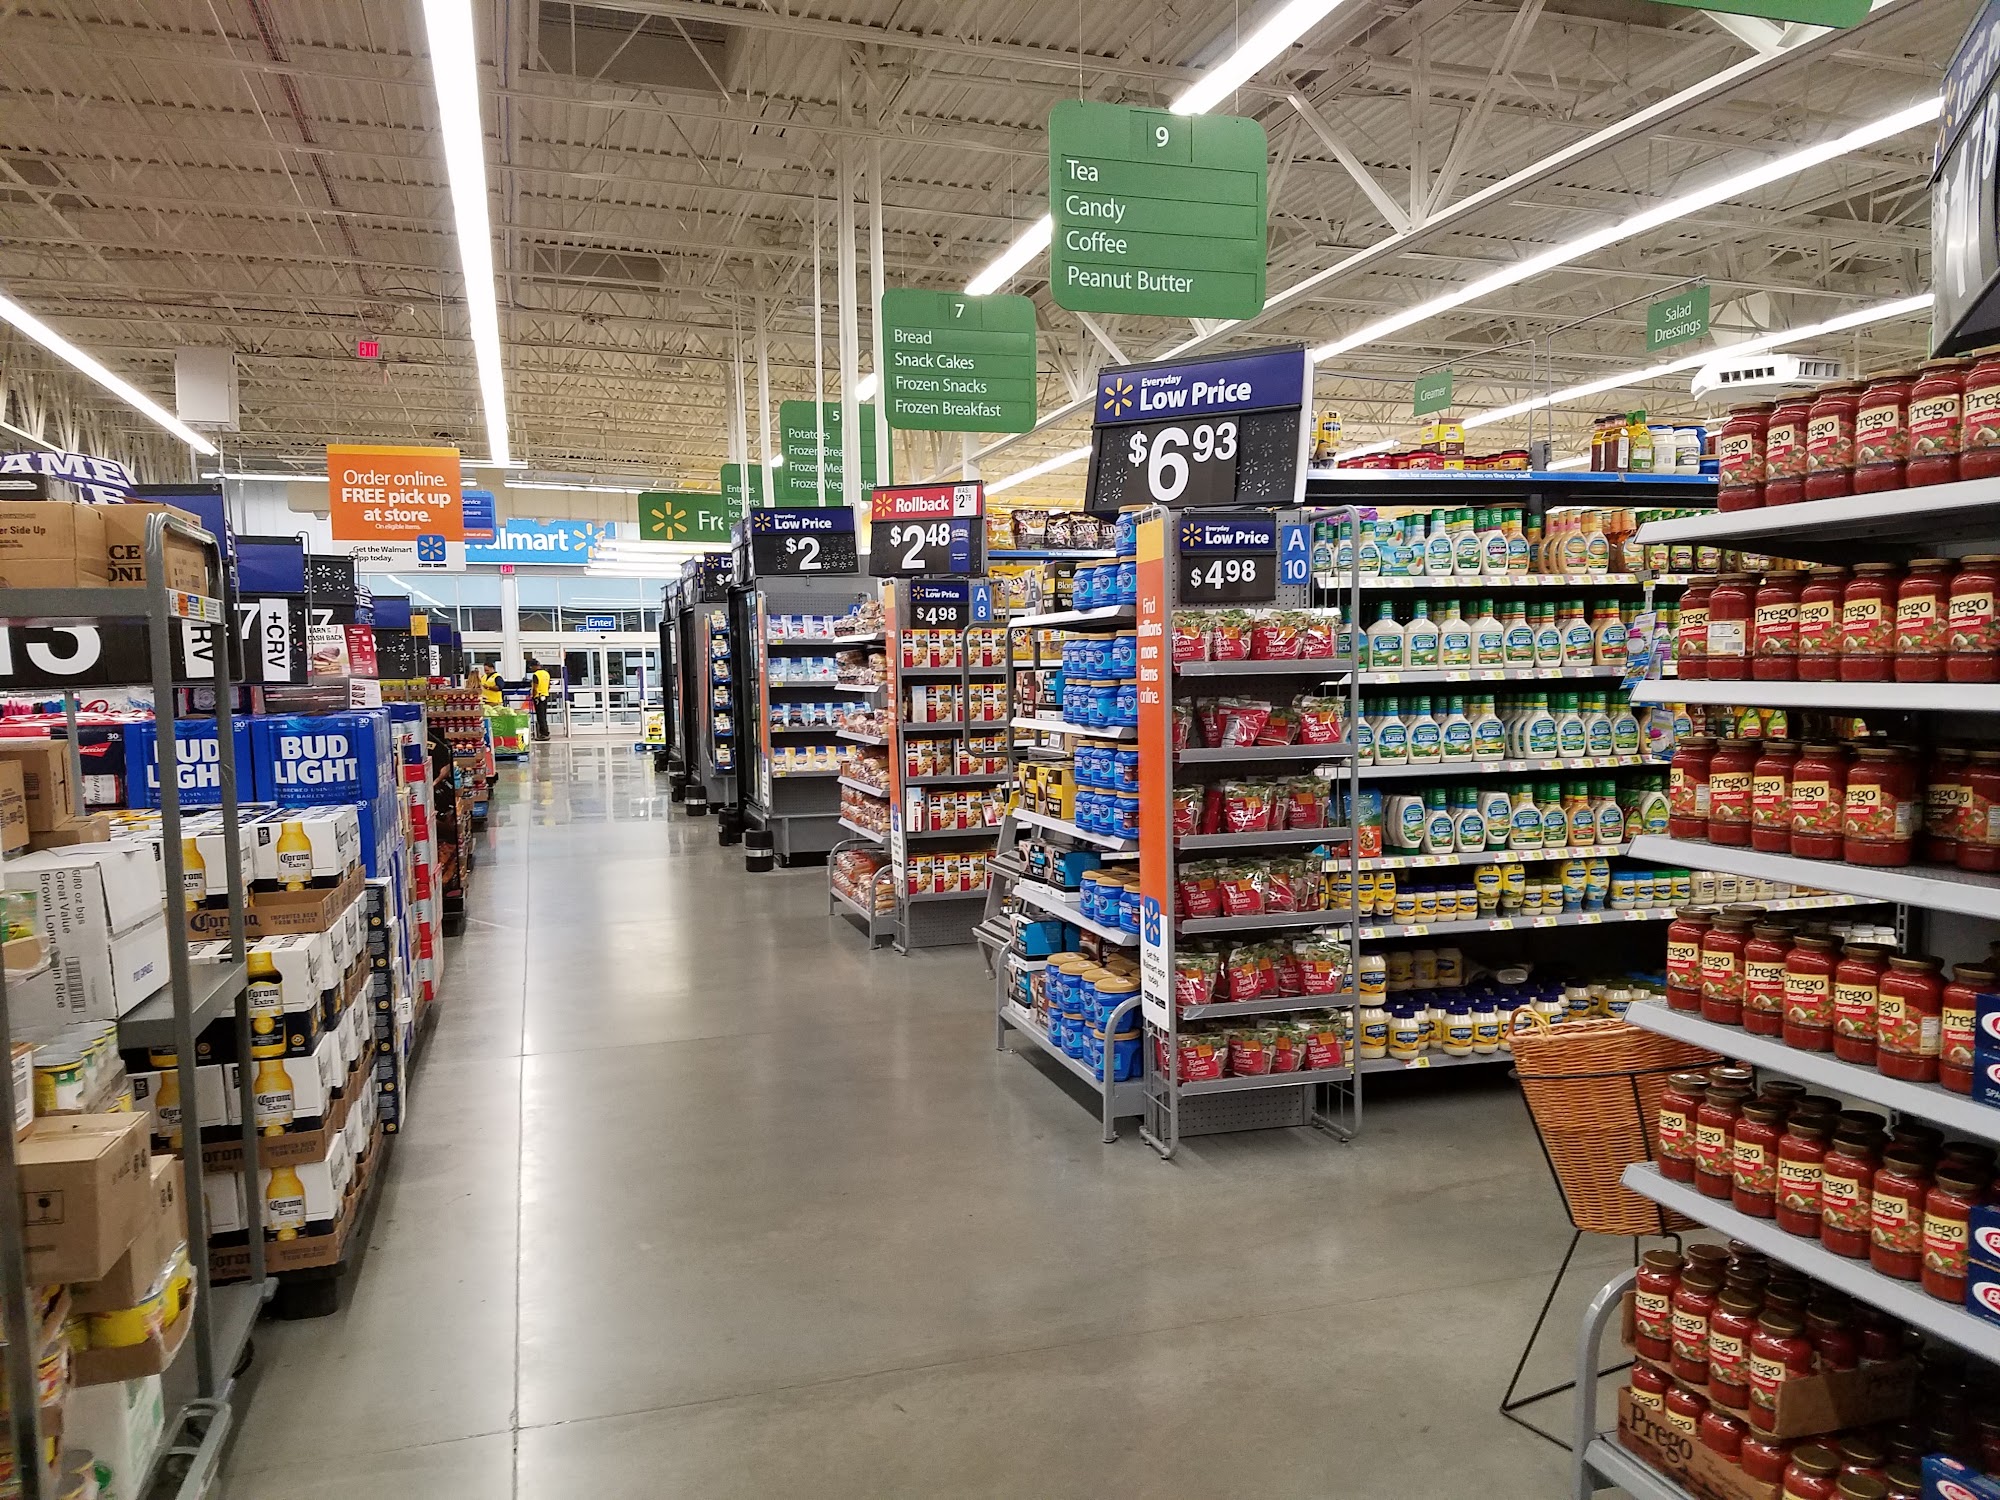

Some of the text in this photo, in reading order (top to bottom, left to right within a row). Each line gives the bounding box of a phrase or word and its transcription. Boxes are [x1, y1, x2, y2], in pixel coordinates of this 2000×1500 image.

[1155, 126, 1170, 147] 9
[1066, 159, 1099, 182] Tea
[1066, 196, 1126, 224] Candy
[1066, 231, 1128, 254] Coffee
[1068, 266, 1194, 293] Peanut Butter
[955, 304, 965, 318] 7
[1666, 301, 1691, 323] Salad
[894, 329, 932, 344] Bread
[1655, 317, 1701, 343] Dressings
[360, 342, 378, 356] EXIT
[895, 352, 975, 370] Snack Cakes
[896, 376, 987, 393] Frozen Snacks
[1141, 375, 1182, 388] Everyday
[1140, 379, 1252, 411] Low Price
[1421, 386, 1446, 401] Creamer
[1966, 388, 2000, 413] Preg
[832, 411, 840, 421] 5
[896, 400, 1001, 417] Frozen Breakfast
[1909, 399, 1955, 422] Prego
[824, 447, 843, 456] Brea
[1, 453, 129, 489] AME
[343, 470, 447, 487] Order online.
[342, 488, 451, 508] FREE pick up
[896, 496, 949, 512] Rollback
[364, 508, 431, 522] at store.
[10, 526, 46, 536] Side Up
[774, 519, 832, 530] Low Price
[1205, 531, 1269, 545] Low Price
[1288, 529, 1305, 551] A
[786, 537, 822, 570] $2
[721, 560, 732, 568] Lo
[1284, 560, 1307, 579] 10
[926, 590, 960, 599] Low Price
[976, 588, 988, 602] A
[851, 607, 859, 616] A
[977, 606, 987, 618] 8
[1142, 596, 1156, 614] Find
[589, 618, 612, 627] Enter
[1757, 605, 1798, 624] Prego
[1138, 620, 1162, 636] millions
[1758, 624, 1792, 634] Traditional
[266, 612, 286, 669] +CRV
[1141, 646, 1158, 659] more
[1141, 666, 1158, 682] items
[1386, 734, 1404, 742] Ranch
[281, 735, 348, 760] BUD
[274, 758, 358, 784] LIGHT
[1711, 774, 1749, 791] Prego
[280, 853, 310, 863] Corona
[55, 872, 72, 934] Great Value
[75, 892, 82, 904] oz
[75, 906, 85, 925] bgs
[293, 917, 316, 925] MEXICO
[40, 874, 52, 910] Brown
[54, 982, 66, 1009] Rice
[1944, 1010, 1976, 1031] Preg
[258, 1093, 291, 1104] Corona
[1780, 1162, 1821, 1181] Prego
[1630, 1403, 1693, 1465] Prego
